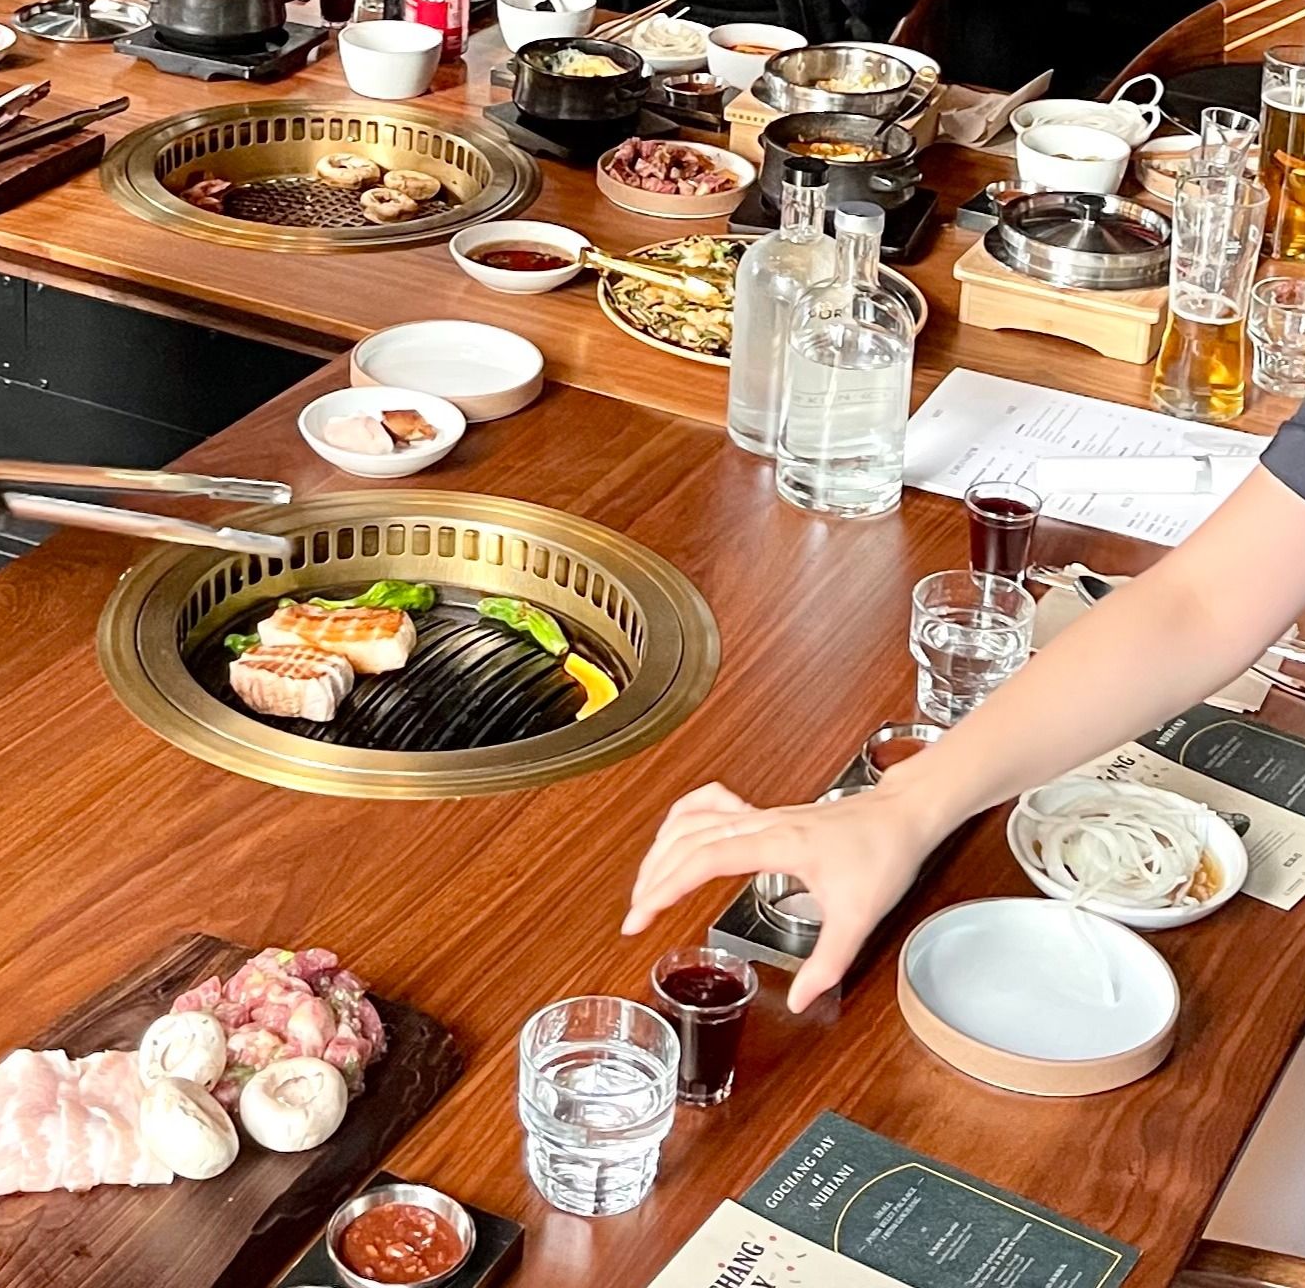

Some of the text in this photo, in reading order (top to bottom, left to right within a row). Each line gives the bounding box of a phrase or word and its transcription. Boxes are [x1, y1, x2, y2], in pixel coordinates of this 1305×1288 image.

[765, 1135, 836, 1209] GOCHANG DAY
[810, 1173, 825, 1187] at
[708, 1241, 765, 1288] HANG
